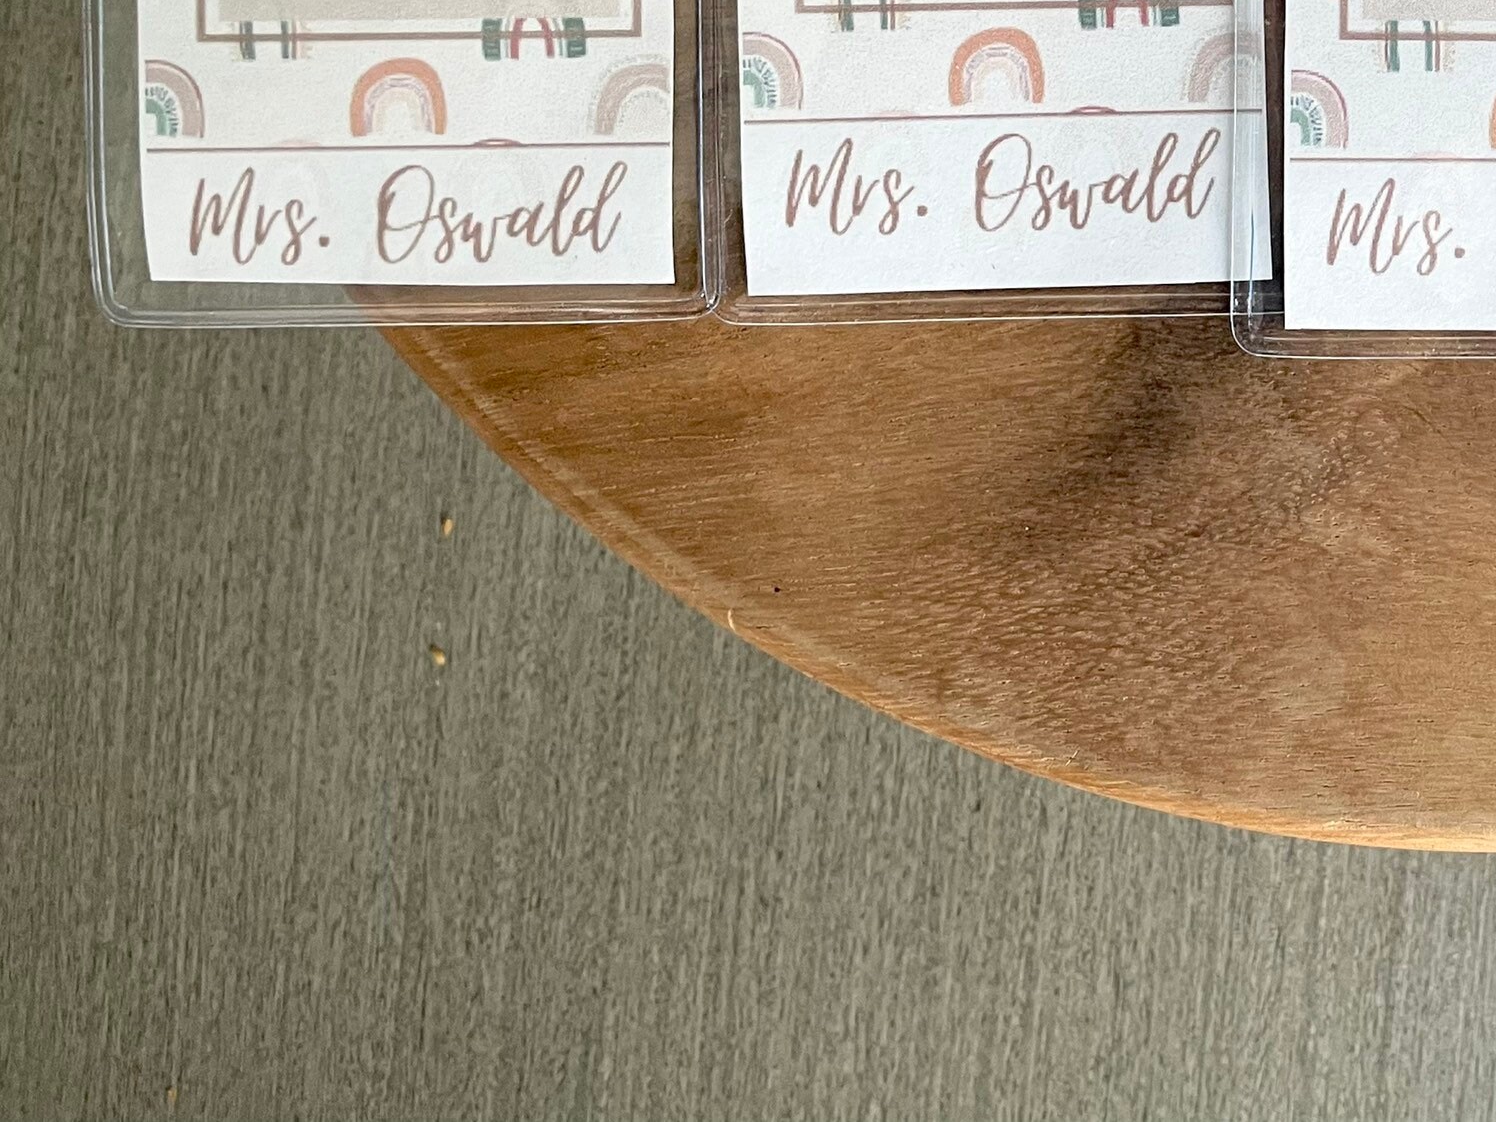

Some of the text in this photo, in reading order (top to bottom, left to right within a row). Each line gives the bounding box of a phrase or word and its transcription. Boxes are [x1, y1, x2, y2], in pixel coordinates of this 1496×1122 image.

[187, 160, 629, 266] Mrs. Oswald
[786, 127, 1222, 236] Mrs. Oswald
[1325, 178, 1466, 276] Mrs.
